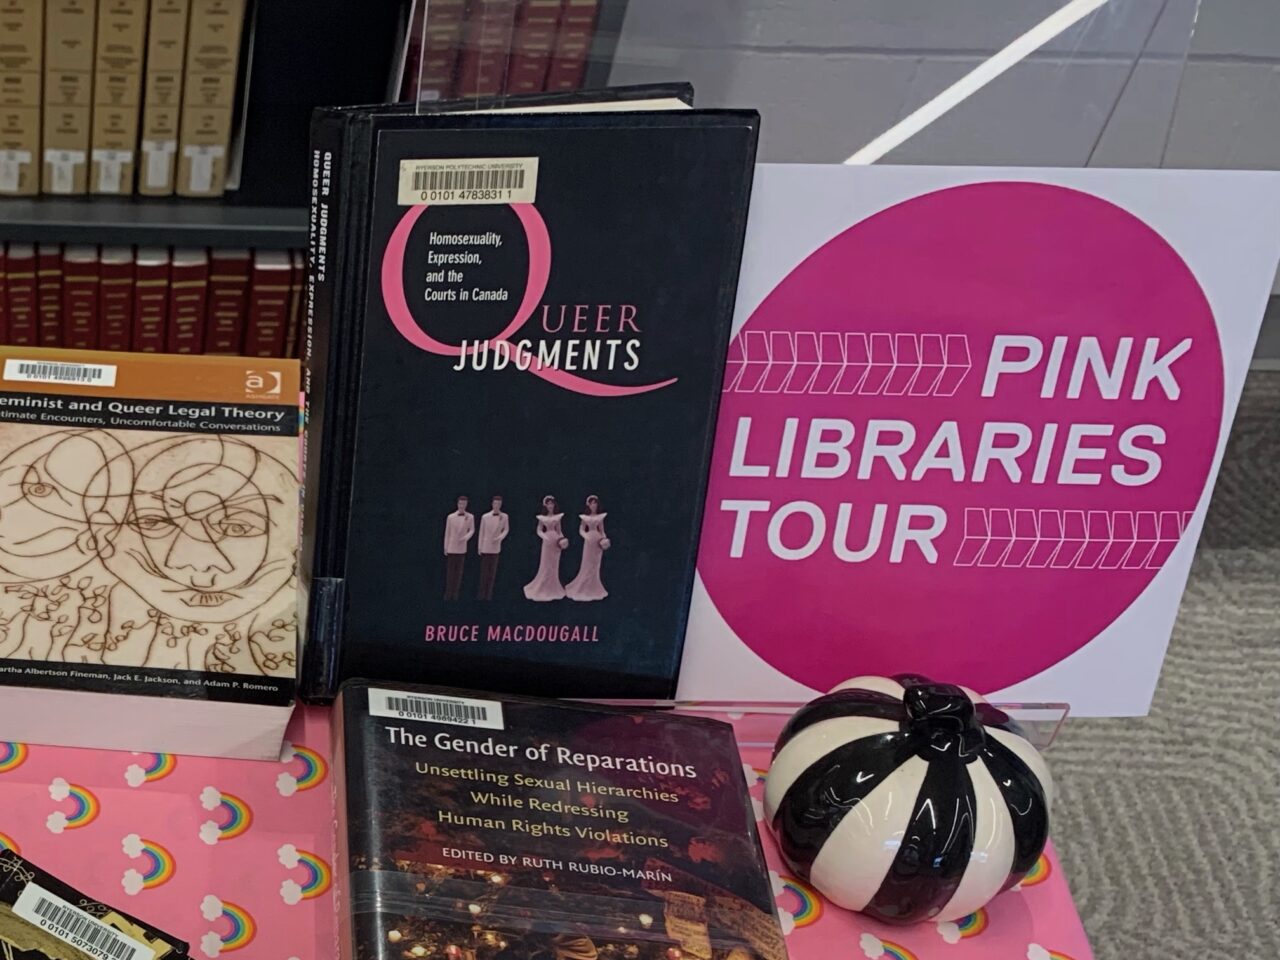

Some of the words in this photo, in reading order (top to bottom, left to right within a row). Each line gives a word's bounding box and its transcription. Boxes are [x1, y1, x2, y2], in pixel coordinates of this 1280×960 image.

[321, 152, 332, 196] QUEER
[430, 191, 455, 200] 0101
[458, 190, 503, 199] 4783831
[317, 203, 329, 281] JUDGMENTS
[429, 232, 503, 248] Homosexuality,
[428, 251, 482, 266] Expression,
[426, 270, 444, 282] and
[447, 270, 464, 282] the
[424, 288, 456, 301] Courts
[459, 288, 469, 301] in
[472, 288, 508, 301] Canada
[453, 340, 642, 372] JUDGMENTS
[980, 335, 1193, 400] PINK
[40, 411, 106, 425] Encounters,
[110, 416, 196, 429] Uncomfortable
[200, 420, 281, 432] Conversations
[68, 398, 103, 412] and
[108, 401, 163, 416] Queer
[169, 405, 216, 420] Legal
[221, 406, 286, 422] Theory
[729, 416, 1167, 486] LIBRARIES
[720, 499, 948, 564] TOUR
[425, 625, 479, 642] BRUCE
[487, 625, 600, 642] MACDOUGALL
[24, 667, 68, 677] Albertson
[70, 670, 110, 680] Fineman,
[113, 672, 132, 682] Jack
[144, 675, 181, 685] Jackson,
[183, 677, 201, 686] and
[203, 679, 230, 688] Adam
[242, 682, 279, 692] Romero
[385, 726, 427, 748] The
[434, 732, 518, 759] Gender
[525, 743, 553, 763] of
[556, 747, 698, 780] Reparations
[415, 761, 510, 788] Unsettling
[513, 771, 572, 793] Sexual
[576, 780, 679, 804] Hierarchies
[470, 790, 524, 810] While
[529, 797, 630, 824] Redressing
[437, 810, 506, 832] Human
[512, 818, 572, 841] Rights
[576, 826, 670, 849] Violations
[442, 847, 495, 864] EDITED
[498, 853, 519, 867] BY
[522, 857, 565, 873] RUTH
[568, 861, 673, 884] RUBIO-MARÍN
[47, 923, 70, 939] 0101
[70, 935, 109, 960] 5073079
